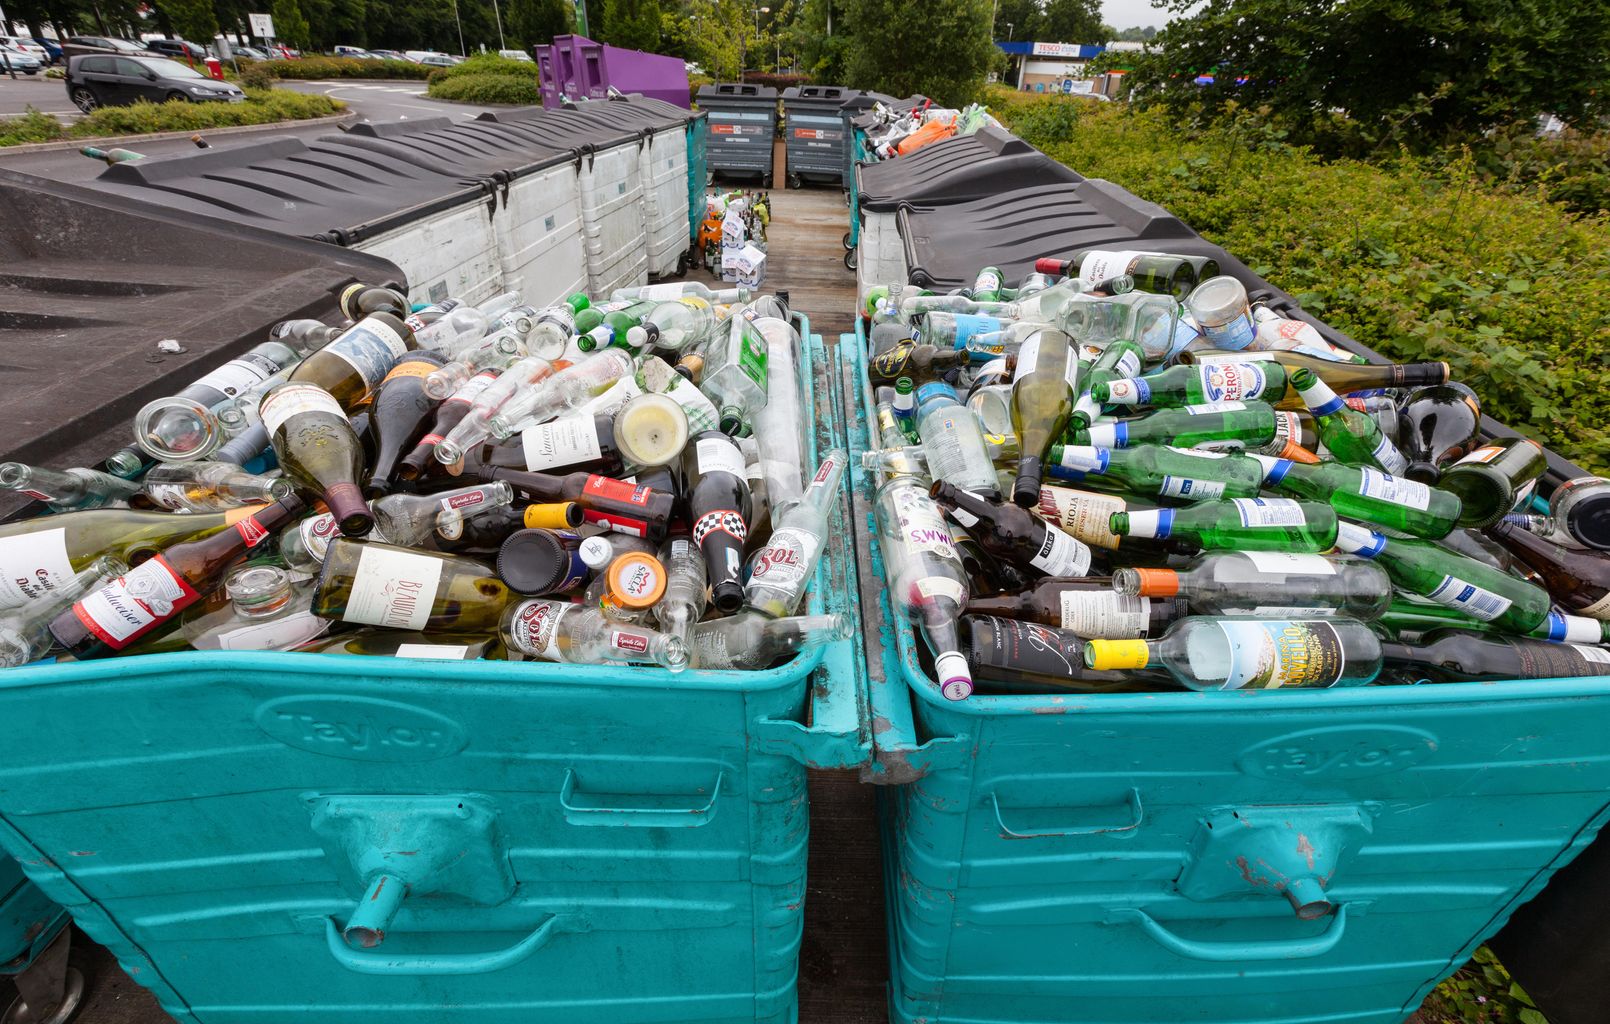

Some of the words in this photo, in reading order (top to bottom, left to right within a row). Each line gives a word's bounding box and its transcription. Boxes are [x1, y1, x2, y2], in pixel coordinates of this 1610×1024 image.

[1039, 44, 1060, 52] TESCO
[1066, 497, 1079, 528] RIOJA
[1078, 499, 1089, 535] RESERVA
[1278, 636, 1291, 681] MARINA
[1285, 627, 1308, 685] COVELLO
